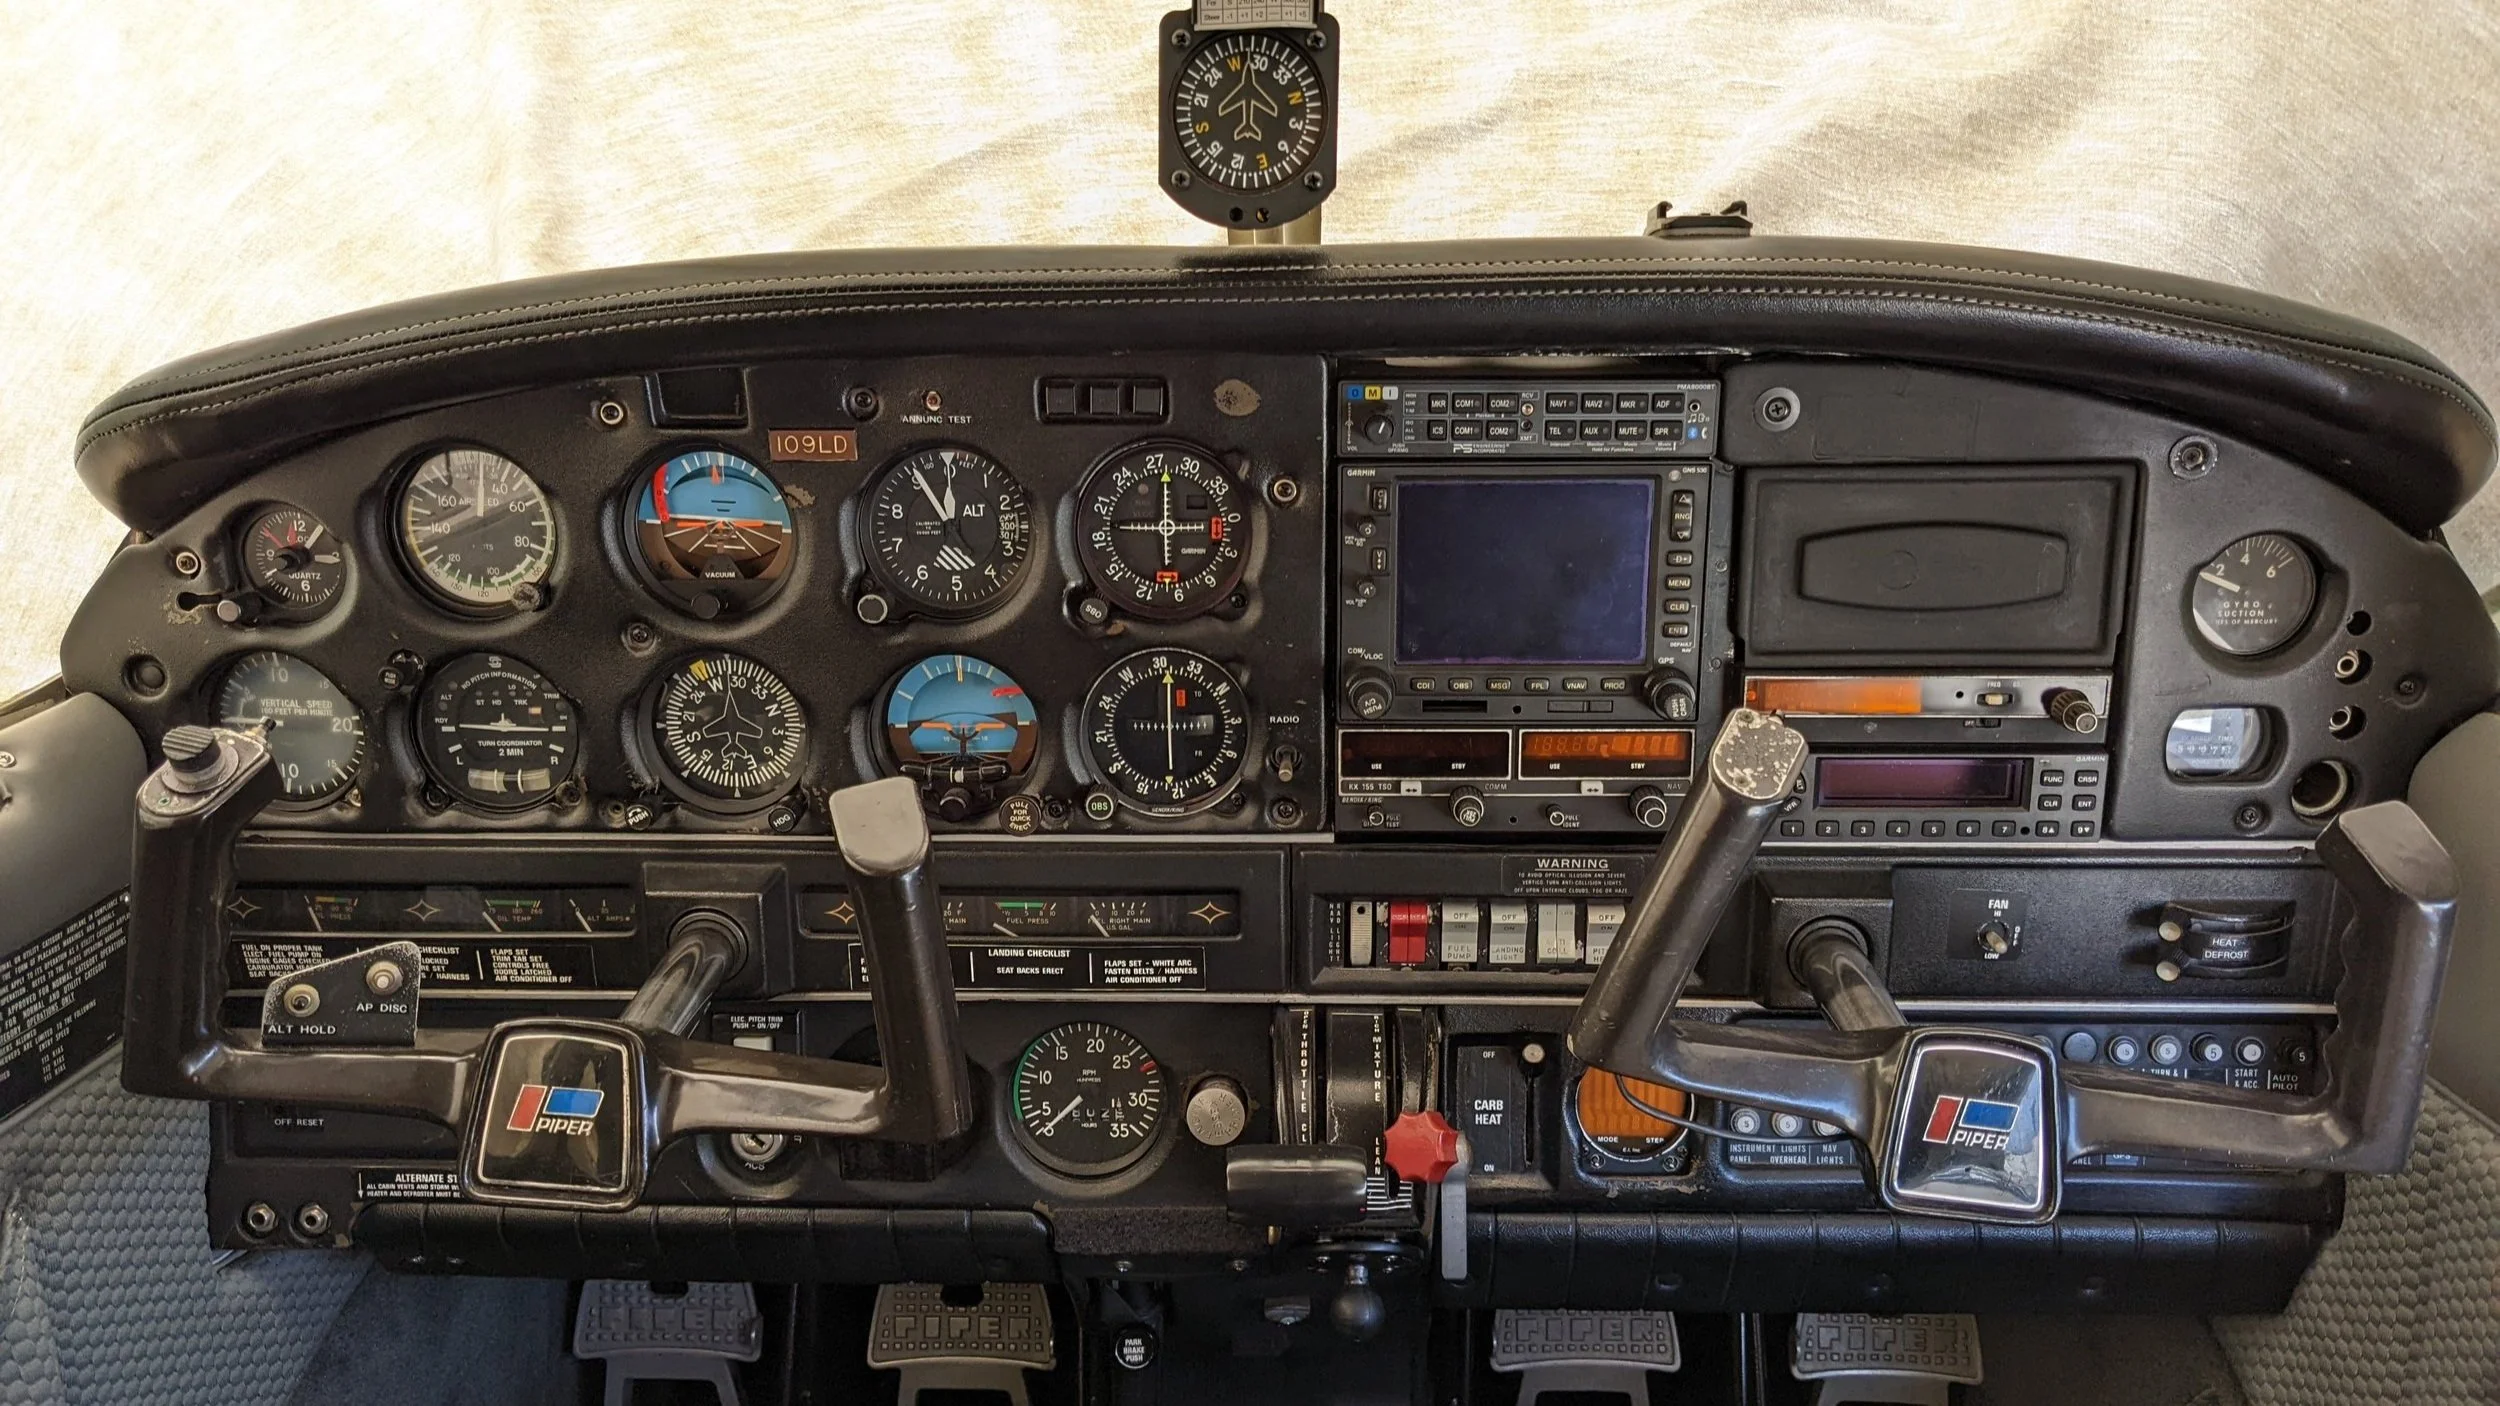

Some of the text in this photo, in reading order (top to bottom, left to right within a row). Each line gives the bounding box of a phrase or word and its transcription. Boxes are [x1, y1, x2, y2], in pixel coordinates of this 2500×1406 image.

[1250, 55, 1268, 71] 30
[1204, 67, 1223, 88] 24
[902, 416, 972, 424] ANNUNC TEST
[1490, 427, 1508, 435] COM2
[777, 435, 847, 454] 109LD
[1146, 454, 1164, 469] 27
[1180, 458, 1200, 473] 30
[1112, 466, 1132, 487] 24
[492, 484, 508, 494] 40
[1210, 476, 1229, 495] 33
[438, 496, 456, 507] 160
[509, 502, 526, 512] 60
[1000, 495, 1011, 510] 2
[963, 504, 985, 517] ALT
[1228, 512, 1240, 523] 0
[293, 520, 306, 532] 12
[431, 524, 450, 534] 140
[515, 536, 529, 548] 80
[1002, 541, 1013, 556] 3
[1225, 547, 1238, 558] 3
[301, 581, 310, 591] 6
[952, 576, 962, 591] 5
[1670, 603, 1685, 611] CLR
[1152, 657, 1167, 669] 30
[1187, 661, 1202, 674] 33
[461, 672, 536, 690] NO PITCH INFORMATION
[730, 676, 746, 688] 30
[690, 691, 705, 704] 24
[751, 684, 768, 700] 33
[261, 699, 332, 708] VERTICAL SPEED
[333, 717, 352, 732] 20
[628, 812, 648, 825] PUSH
[773, 814, 790, 827] HDG
[1009, 822, 1031, 831] ERECT
[1537, 859, 1609, 869] WARNING
[1988, 899, 2008, 910] FAN
[2212, 938, 2237, 947] HEAT
[989, 949, 1070, 958] LANDING CHECKLIST
[2205, 950, 2249, 960] DEFROST
[62, 992, 75, 1007] ONLY
[356, 1003, 407, 1013] AP DISC
[268, 1024, 336, 1034] ALT HOLD
[1087, 1039, 1104, 1053] 20
[1112, 1055, 1131, 1069] 25
[1372, 1036, 1381, 1102] MIXTURE
[2234, 1069, 2258, 1077] START
[2272, 1074, 2298, 1082] AUTO
[1474, 1100, 1503, 1110] CARB
[1475, 1114, 1502, 1125] HEAT
[536, 1118, 594, 1137] PIPER
[1110, 1124, 1129, 1138] 35
[1952, 1129, 2009, 1150] PIPER
[1730, 1144, 1775, 1152] INSTRUMENT
[1770, 1156, 1806, 1164] OVERHEAD
[1816, 1156, 1844, 1164] LIGHTS
[1484, 1164, 1494, 1172] ON
[395, 1174, 444, 1182] ALTERNATE
[894, 1315, 1030, 1338] PIPER
[1514, 1317, 1654, 1342] PIPER
[1126, 1354, 1143, 1362] PUSH
